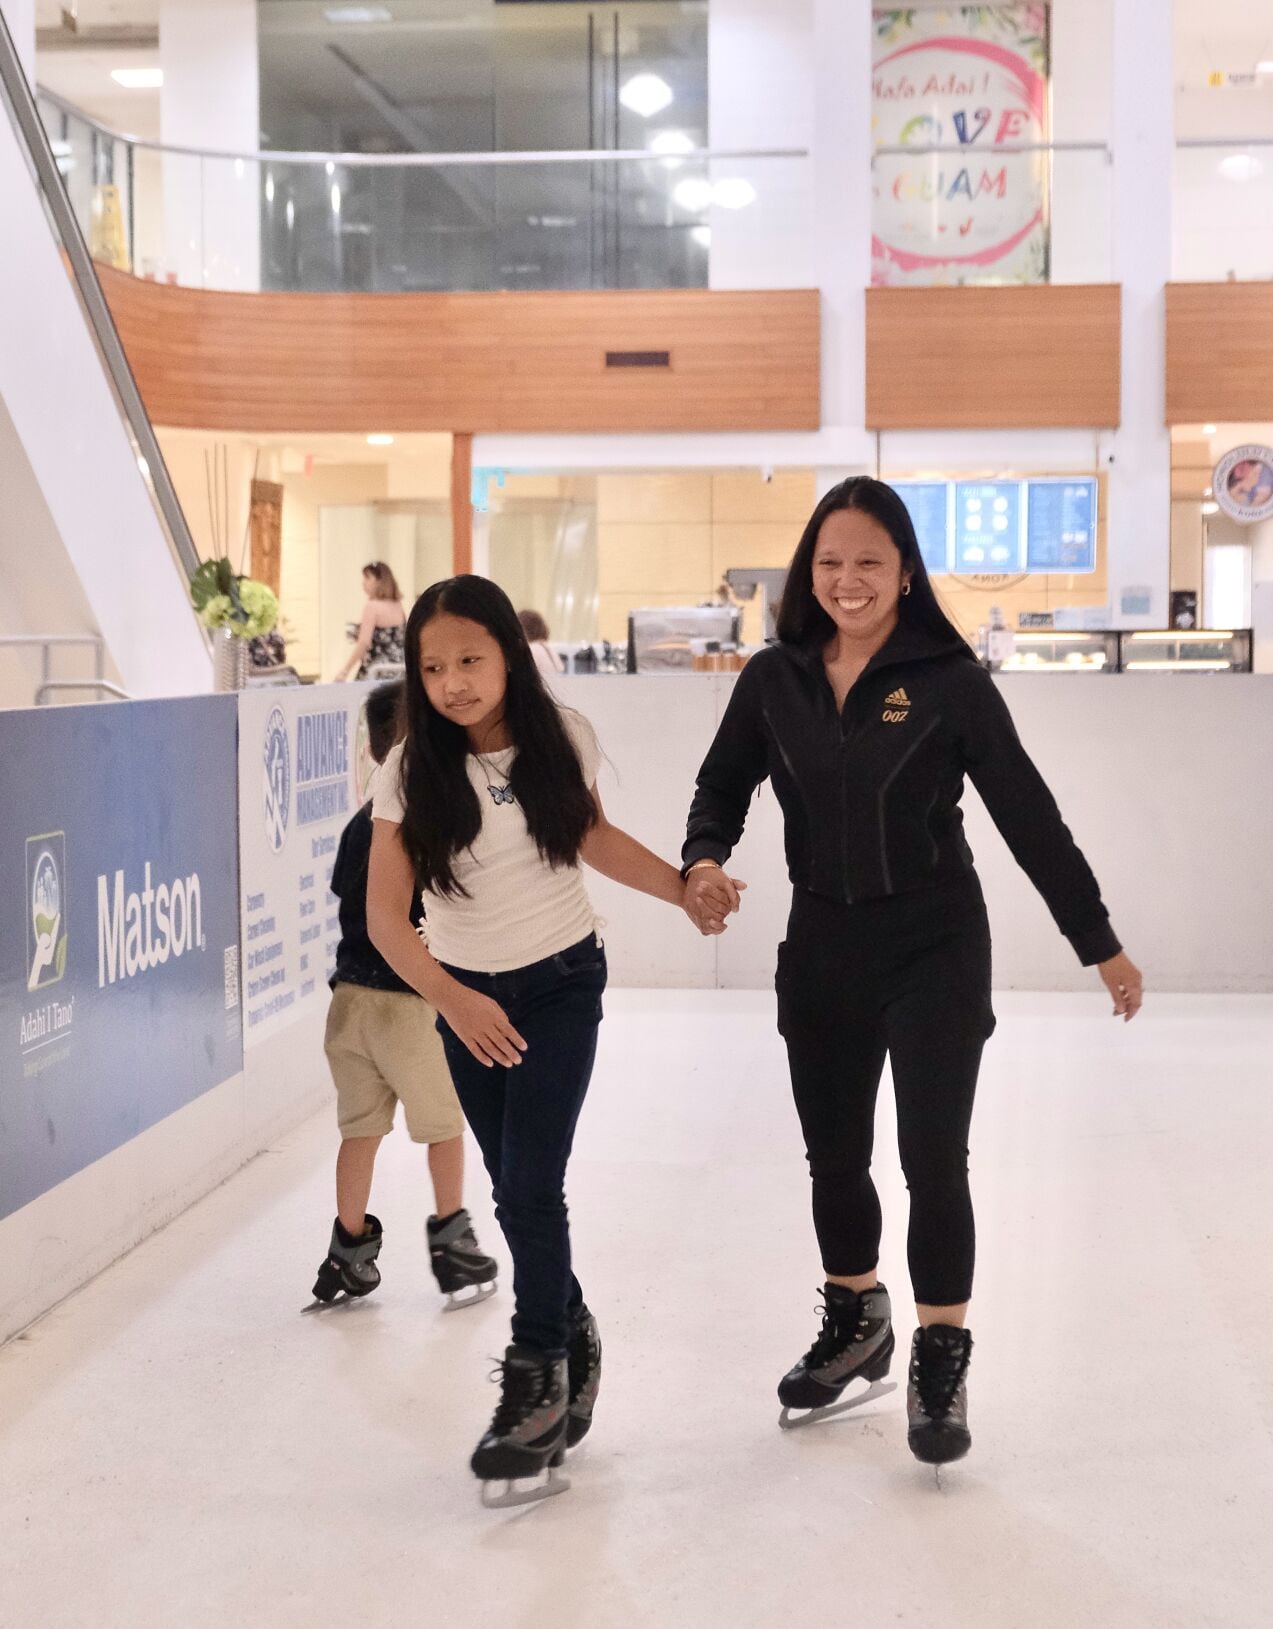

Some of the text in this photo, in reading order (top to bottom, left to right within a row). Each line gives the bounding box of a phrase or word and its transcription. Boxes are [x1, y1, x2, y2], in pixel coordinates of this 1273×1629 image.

[882, 710, 909, 722] 007
[296, 710, 348, 783] ADVANCE
[20, 1006, 46, 1045] Adahi
